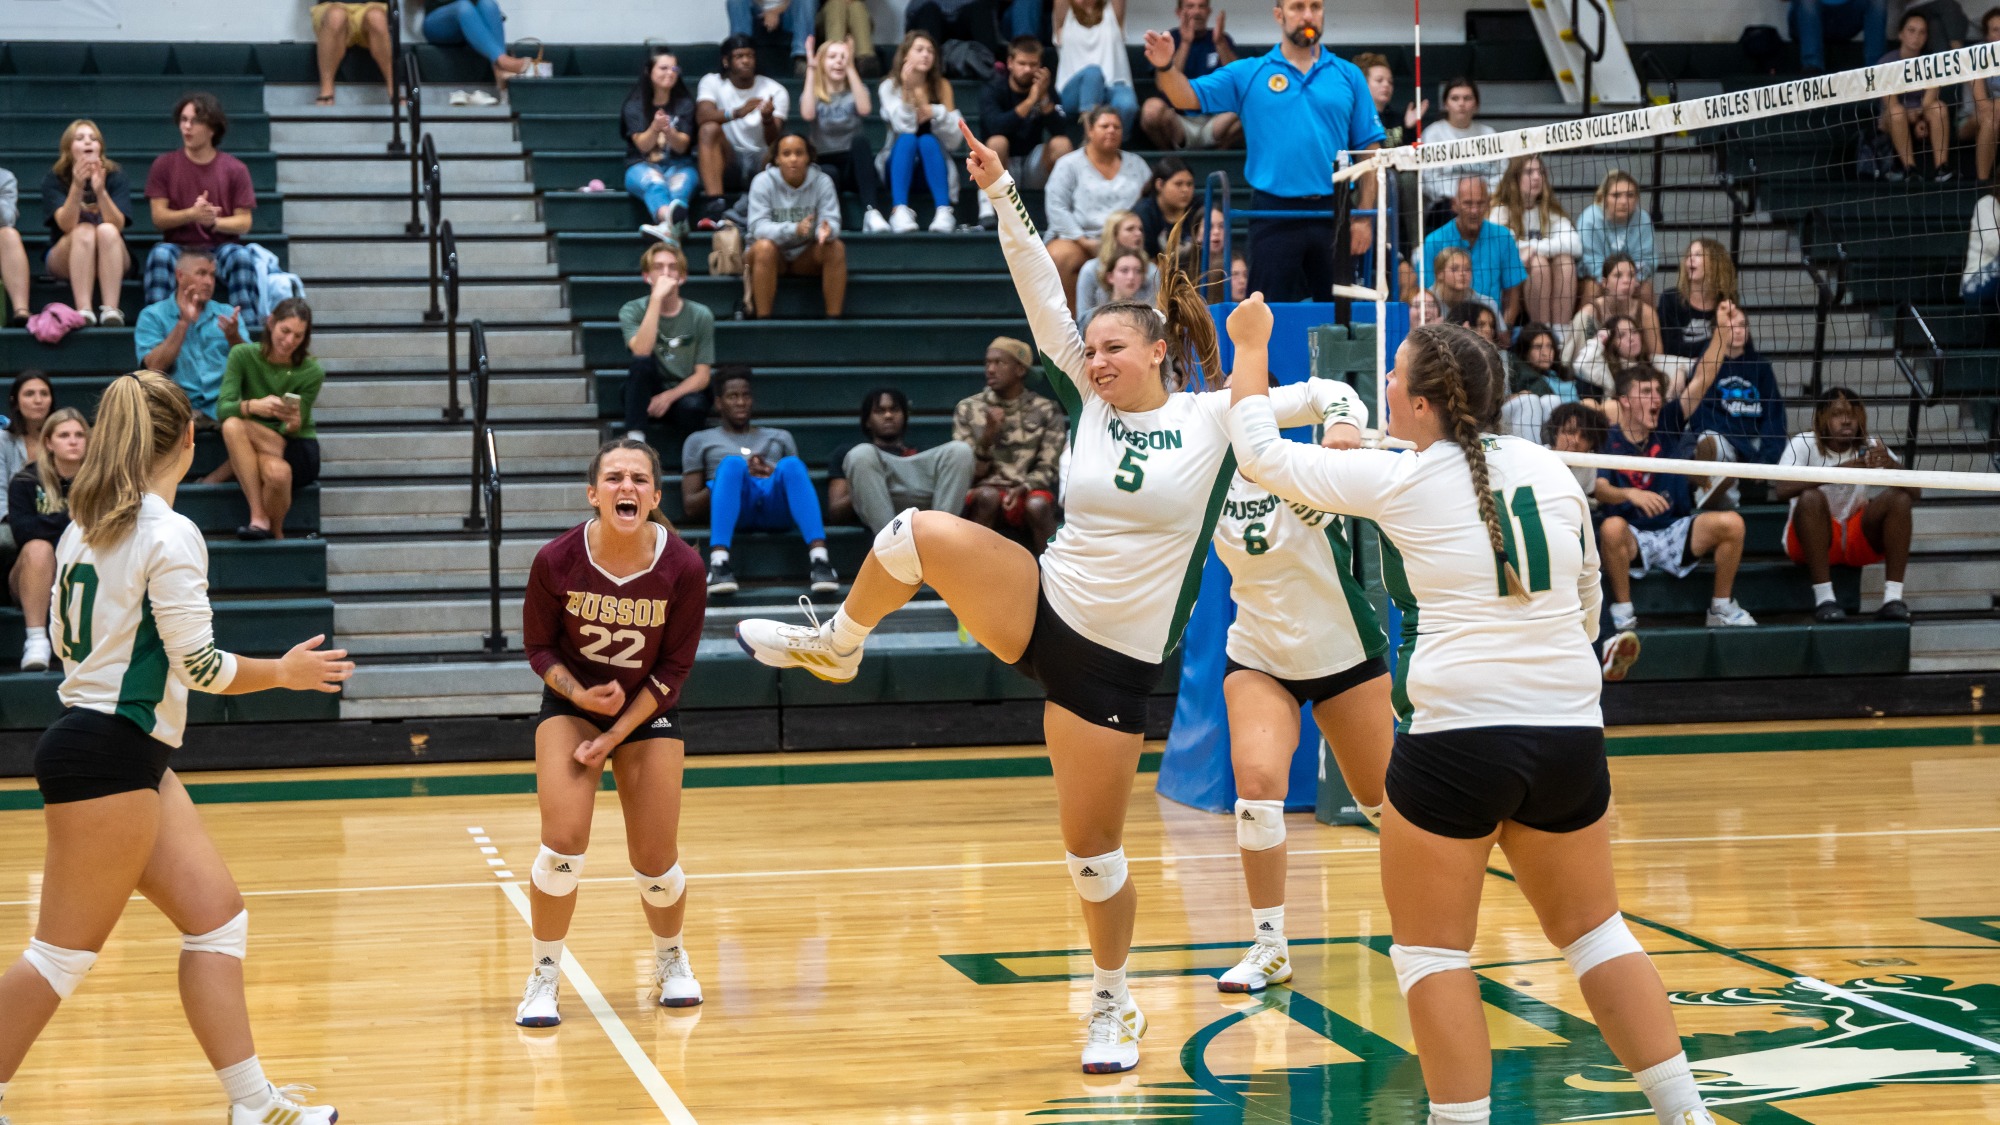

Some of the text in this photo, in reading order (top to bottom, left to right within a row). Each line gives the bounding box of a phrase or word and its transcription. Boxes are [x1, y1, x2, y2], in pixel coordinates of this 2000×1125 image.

[1546, 121, 1583, 144] EAGLES
[1585, 110, 1651, 139] VOLLEYBALL
[1704, 91, 1750, 120] EAGLES
[1754, 77, 1838, 111] VOLLEYBALL
[1903, 50, 1961, 84] EAGLES
[1113, 446, 1149, 494] 5
[1222, 493, 1281, 521] HUSSO
[1243, 522, 1269, 556] 6
[1478, 485, 1553, 598] 11
[565, 590, 669, 628] HUSSON
[579, 623, 646, 669] 22
